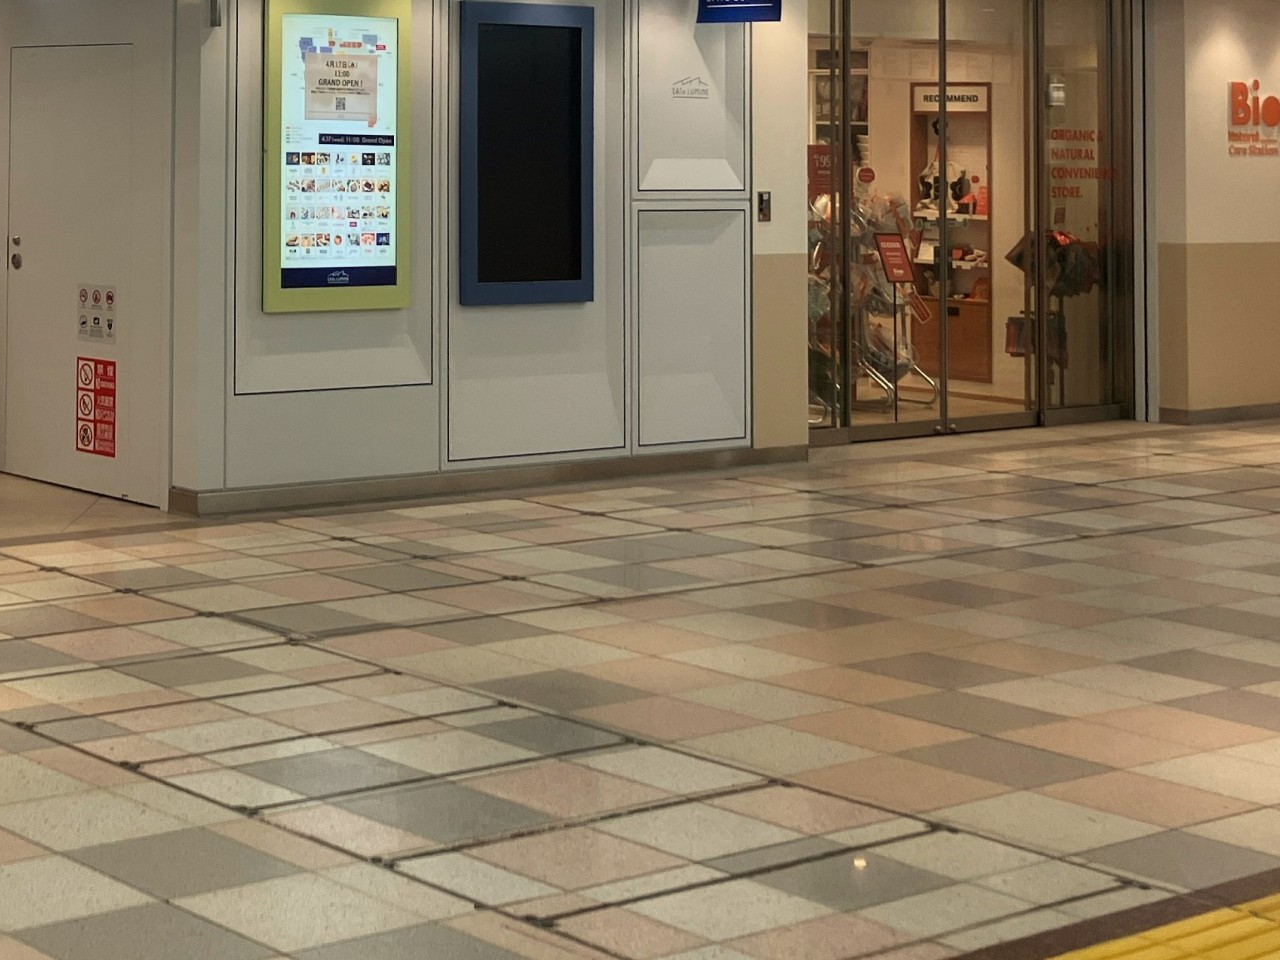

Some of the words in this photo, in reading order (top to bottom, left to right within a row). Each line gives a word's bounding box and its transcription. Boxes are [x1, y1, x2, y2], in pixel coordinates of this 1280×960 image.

[318, 78, 341, 87] GRAND
[923, 94, 979, 103] RECMMEND
[1051, 128, 1095, 141] ORGANIC
[1051, 148, 1095, 160] NATURAL
[1051, 186, 1083, 198] STORE.
